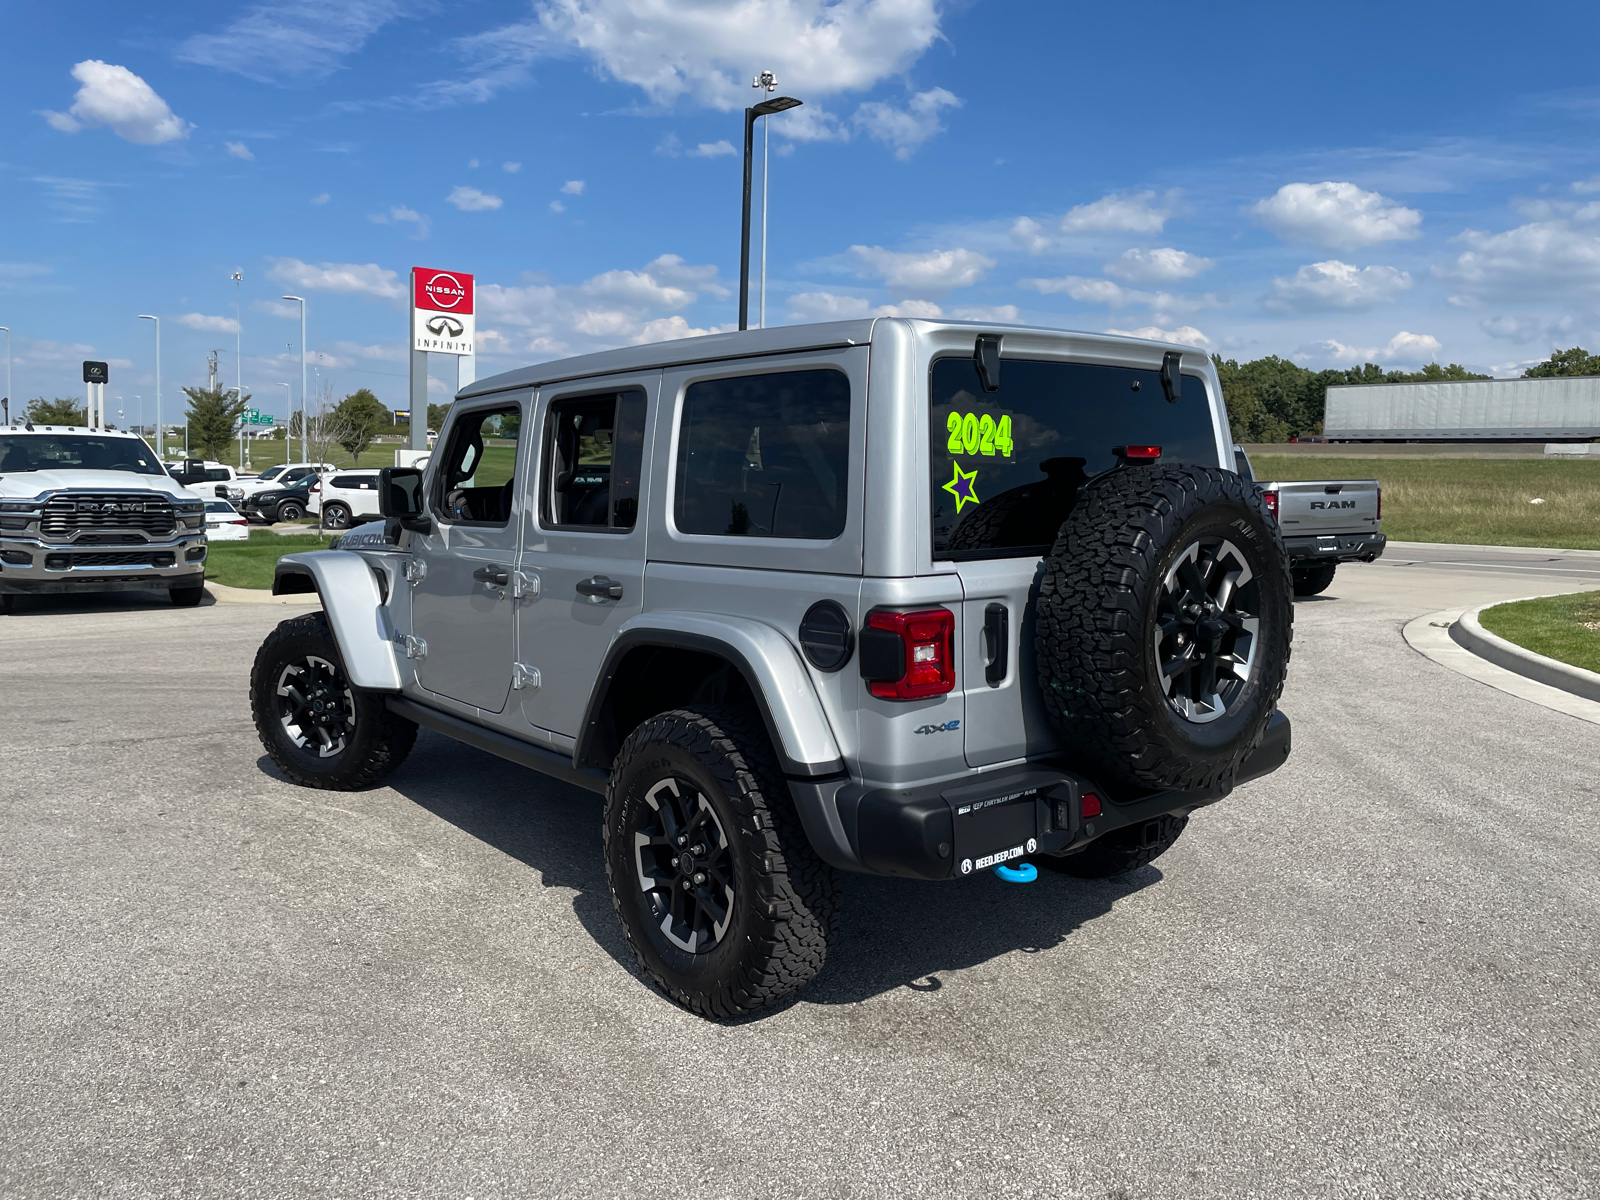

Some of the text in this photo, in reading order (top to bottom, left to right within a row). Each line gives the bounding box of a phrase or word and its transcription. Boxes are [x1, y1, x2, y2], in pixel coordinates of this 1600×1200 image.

[425, 285, 465, 296] NISSAN
[417, 338, 472, 352] INFINITI
[947, 411, 1014, 457] 2024
[79, 502, 143, 511] RAM
[1310, 501, 1356, 509] RAM
[340, 533, 386, 546] RUBICON
[958, 804, 971, 815] REED
[975, 845, 1024, 870] REEDJEEP.COM
